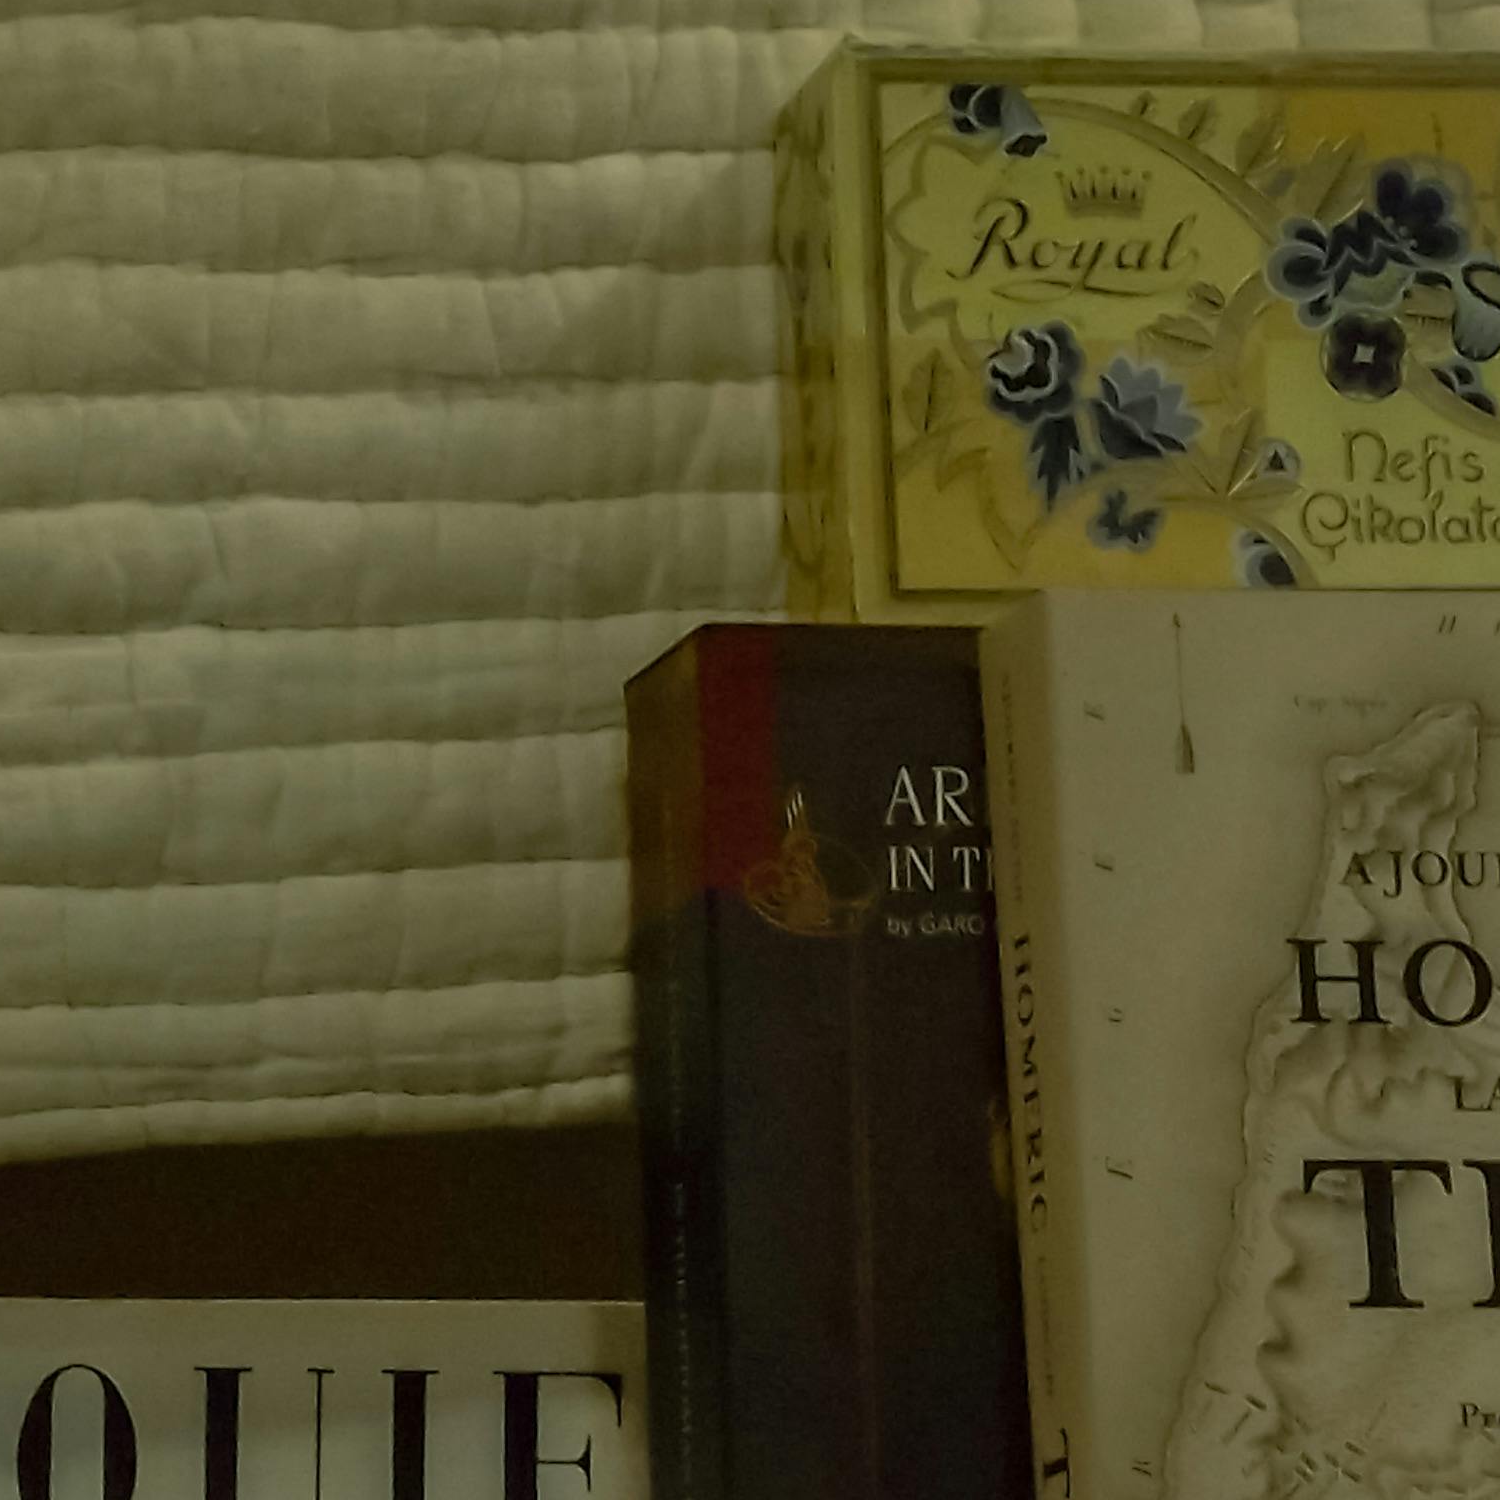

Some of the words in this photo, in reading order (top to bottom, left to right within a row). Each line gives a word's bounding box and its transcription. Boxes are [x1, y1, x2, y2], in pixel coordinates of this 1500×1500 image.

[946, 197, 1198, 299] Royal
[1343, 430, 1487, 488] Nefis
[885, 765, 975, 827] AR
[888, 845, 935, 892] IN
[1339, 852, 1375, 888] A
